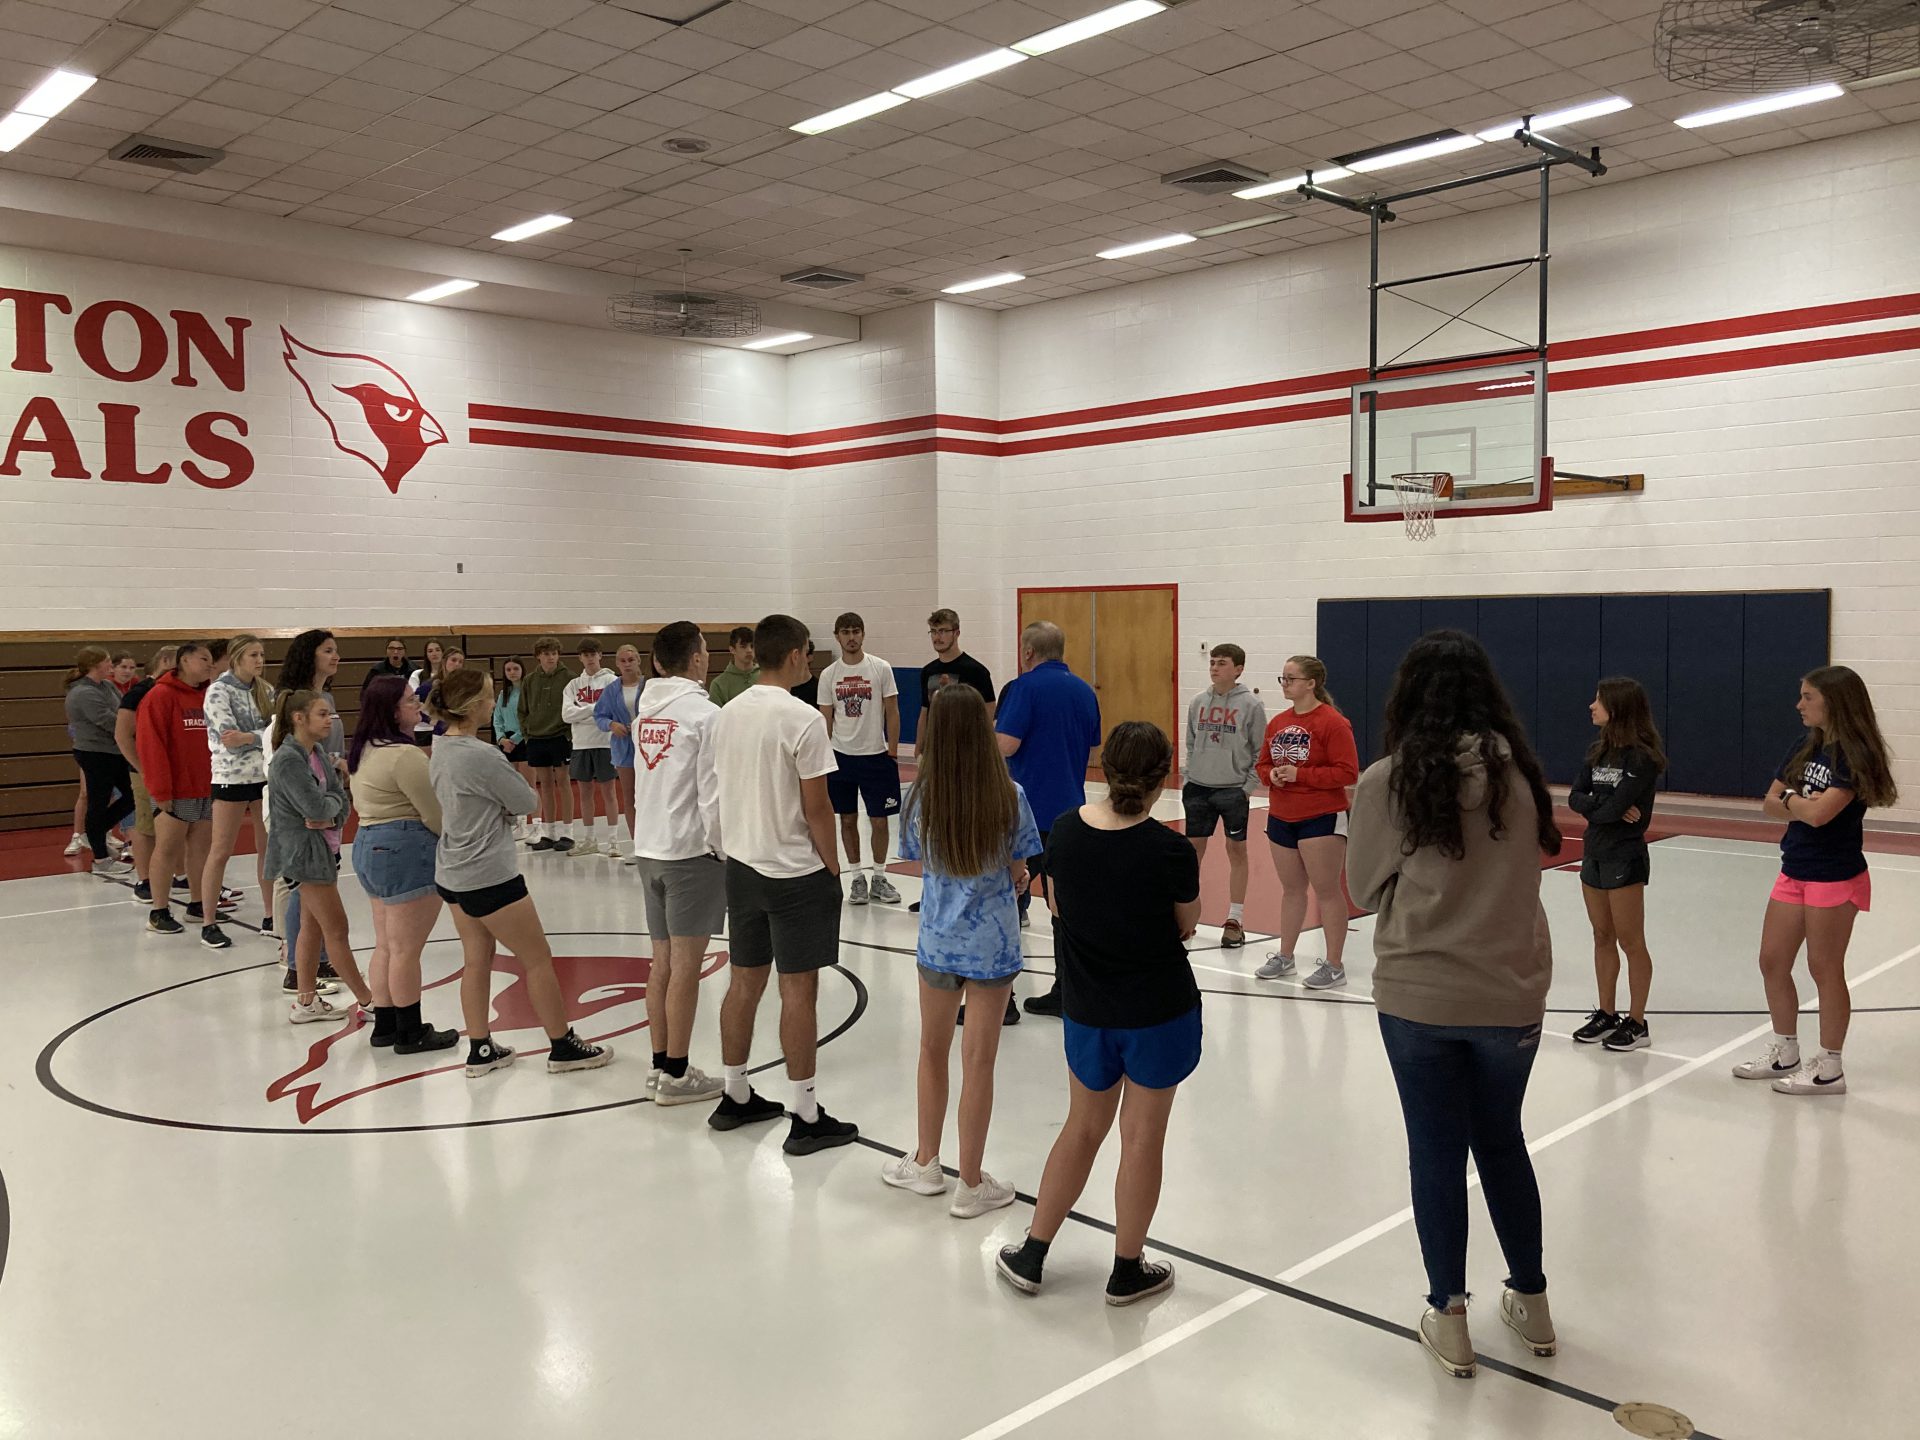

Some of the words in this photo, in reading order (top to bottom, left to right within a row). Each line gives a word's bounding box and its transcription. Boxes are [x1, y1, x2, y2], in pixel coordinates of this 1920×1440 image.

[0, 287, 252, 392] TON
[0, 396, 255, 489] ALS
[1199, 706, 1239, 726] LCK
[640, 729, 667, 744] CASS
[1271, 732, 1310, 745] CHEER
